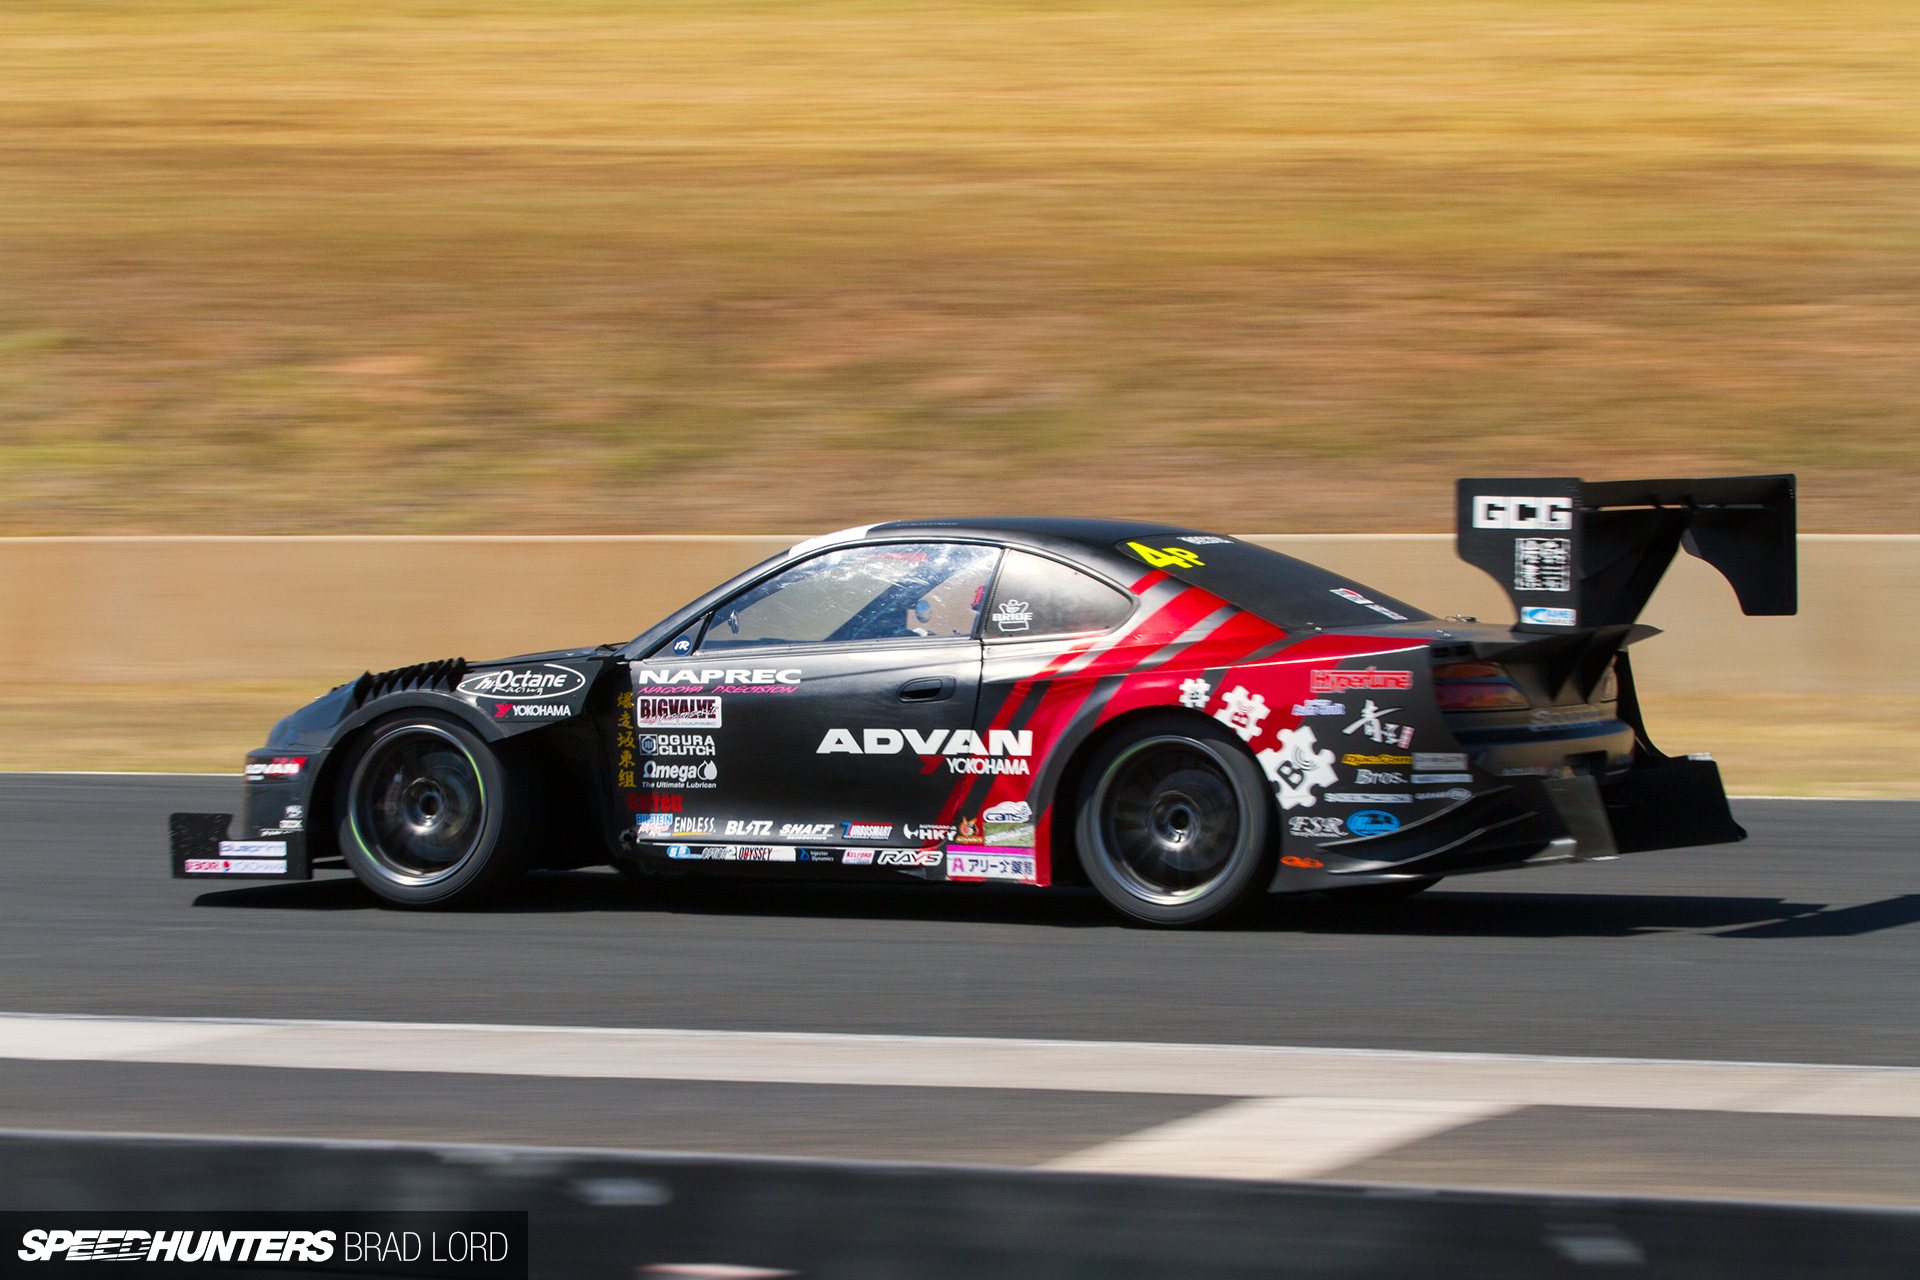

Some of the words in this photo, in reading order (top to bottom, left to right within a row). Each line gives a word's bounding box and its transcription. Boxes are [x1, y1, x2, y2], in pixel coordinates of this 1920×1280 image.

[1472, 496, 1573, 530] GCG
[992, 613, 1033, 621] BRIDE
[638, 669, 801, 684] NAPREC
[637, 686, 703, 694] NAGOYA
[711, 686, 798, 694] PRECISION
[512, 705, 571, 716] YOKOHAMA
[640, 699, 717, 719] BIGVALVE
[658, 734, 715, 745] OGURA
[816, 728, 1032, 756] ADVAN
[659, 745, 716, 756] CLUTCH
[946, 758, 1030, 775] YOKOHAMA
[627, 793, 683, 812] Garrett
[636, 814, 673, 824] BILSTEIN
[724, 820, 773, 836] BLITZ
[780, 824, 835, 835] SHAFT
[919, 829, 957, 841] HKY
[877, 850, 943, 866] RAYS
